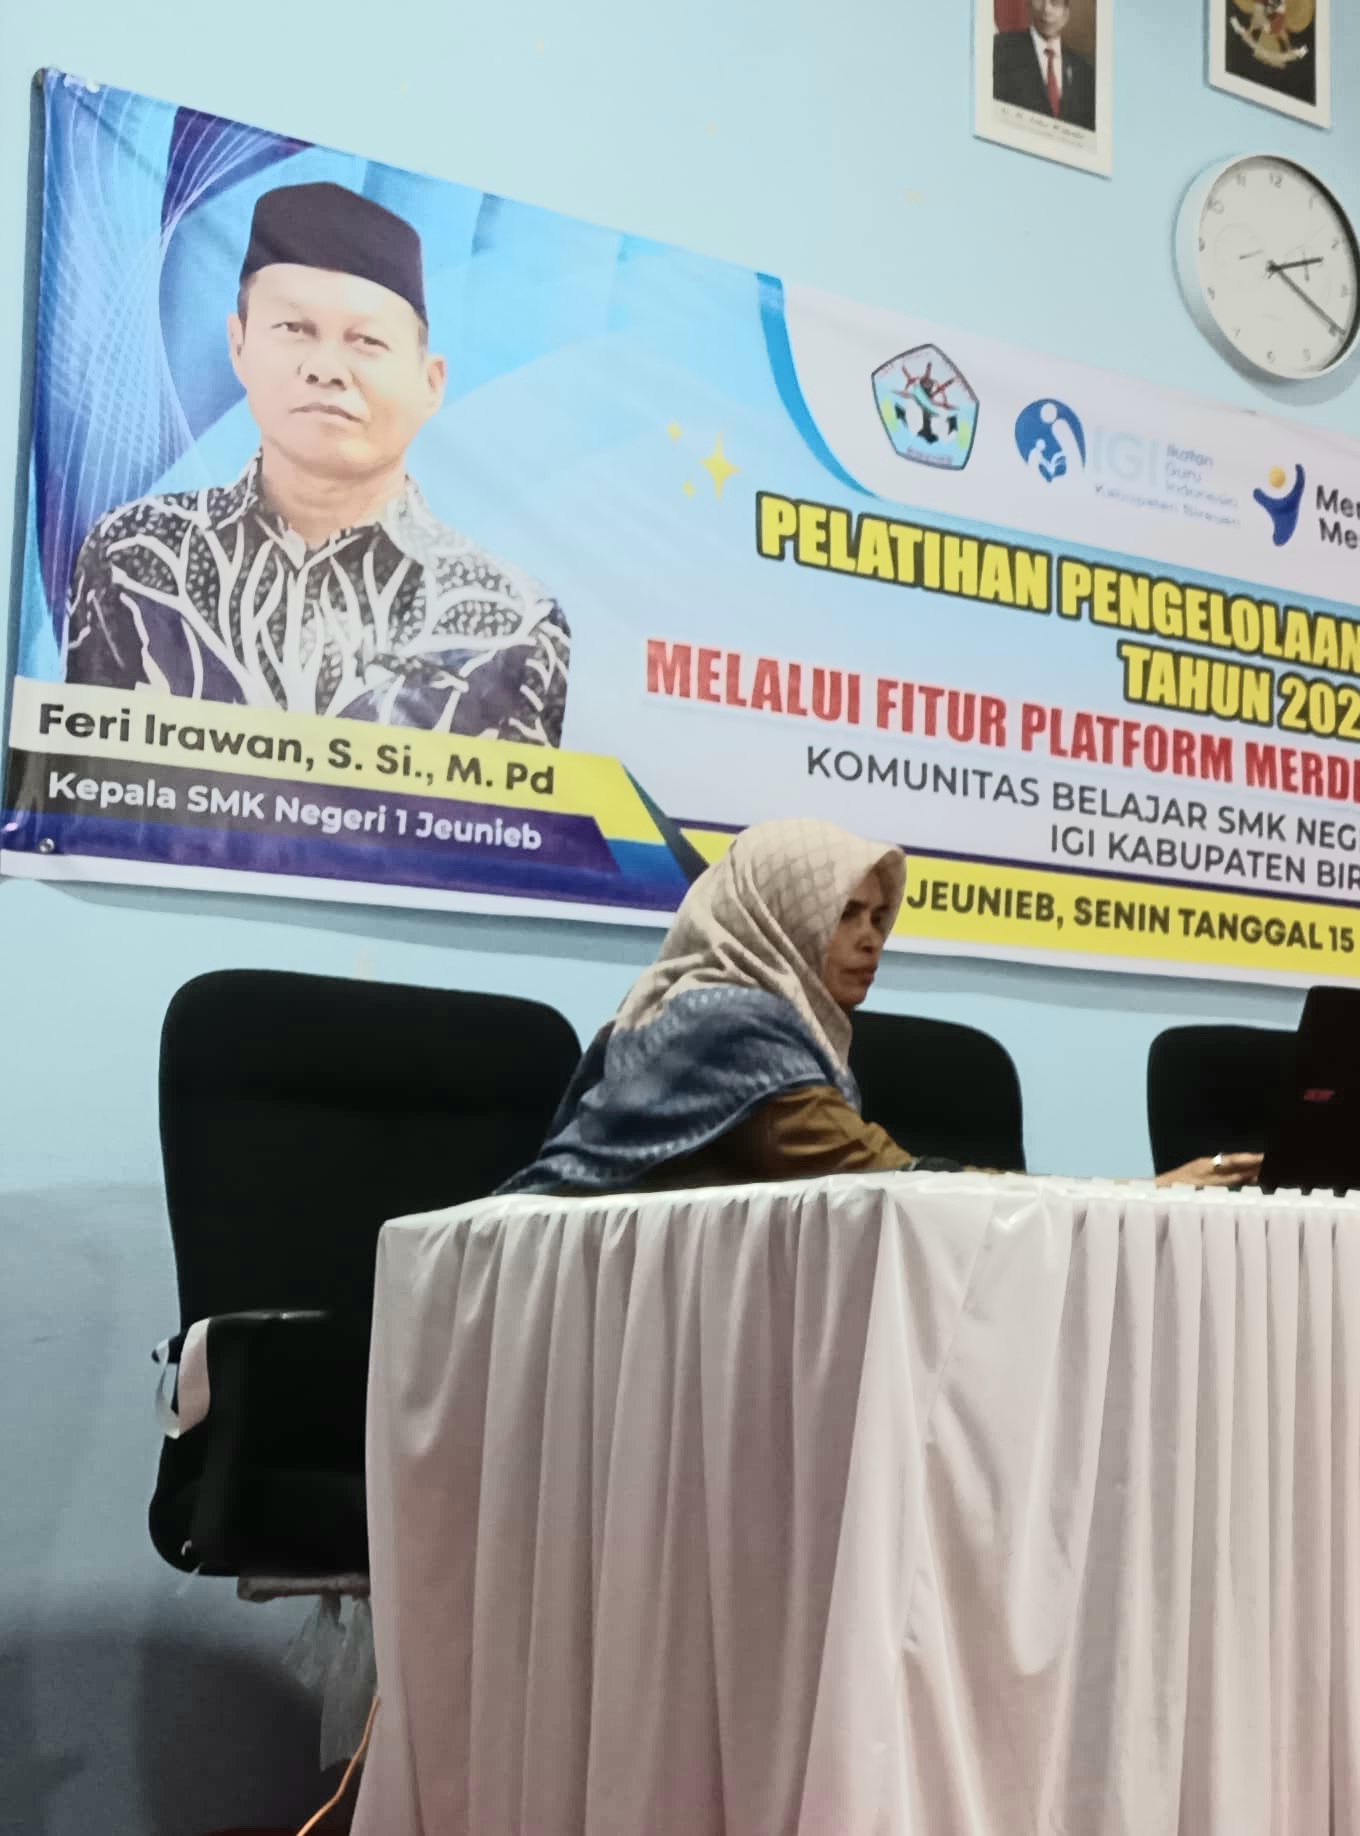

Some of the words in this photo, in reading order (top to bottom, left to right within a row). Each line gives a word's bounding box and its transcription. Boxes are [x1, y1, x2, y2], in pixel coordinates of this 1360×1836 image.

[755, 490, 1052, 616] PELATIHAN
[647, 639, 860, 725] MELALUI
[876, 678, 1007, 748] FITUR
[1021, 703, 1233, 783] PLATFORM
[1117, 638, 1274, 727] TAHUN
[39, 703, 130, 742] Feri
[145, 713, 314, 772] Irawan,
[328, 738, 363, 770] S.
[376, 744, 433, 786] Si.,
[446, 754, 493, 787] M.
[506, 761, 554, 794] Pd
[49, 771, 176, 809] Kepala
[187, 785, 264, 819] SMK
[275, 796, 386, 834] Negeri
[396, 809, 408, 835] 1
[415, 812, 542, 849] Jeunieb
[807, 746, 1040, 807] KOMUNITAS
[1052, 781, 1207, 831] BELAJAR
[1218, 805, 1287, 843] SMK
[1051, 824, 1094, 857] IGI
[1109, 832, 1305, 883] KABUPATEN
[906, 879, 1063, 931] JEUNIEB,
[1074, 896, 1169, 935] SENIN
[1178, 908, 1323, 950] TANGGAL
[1329, 925, 1354, 953] 15
